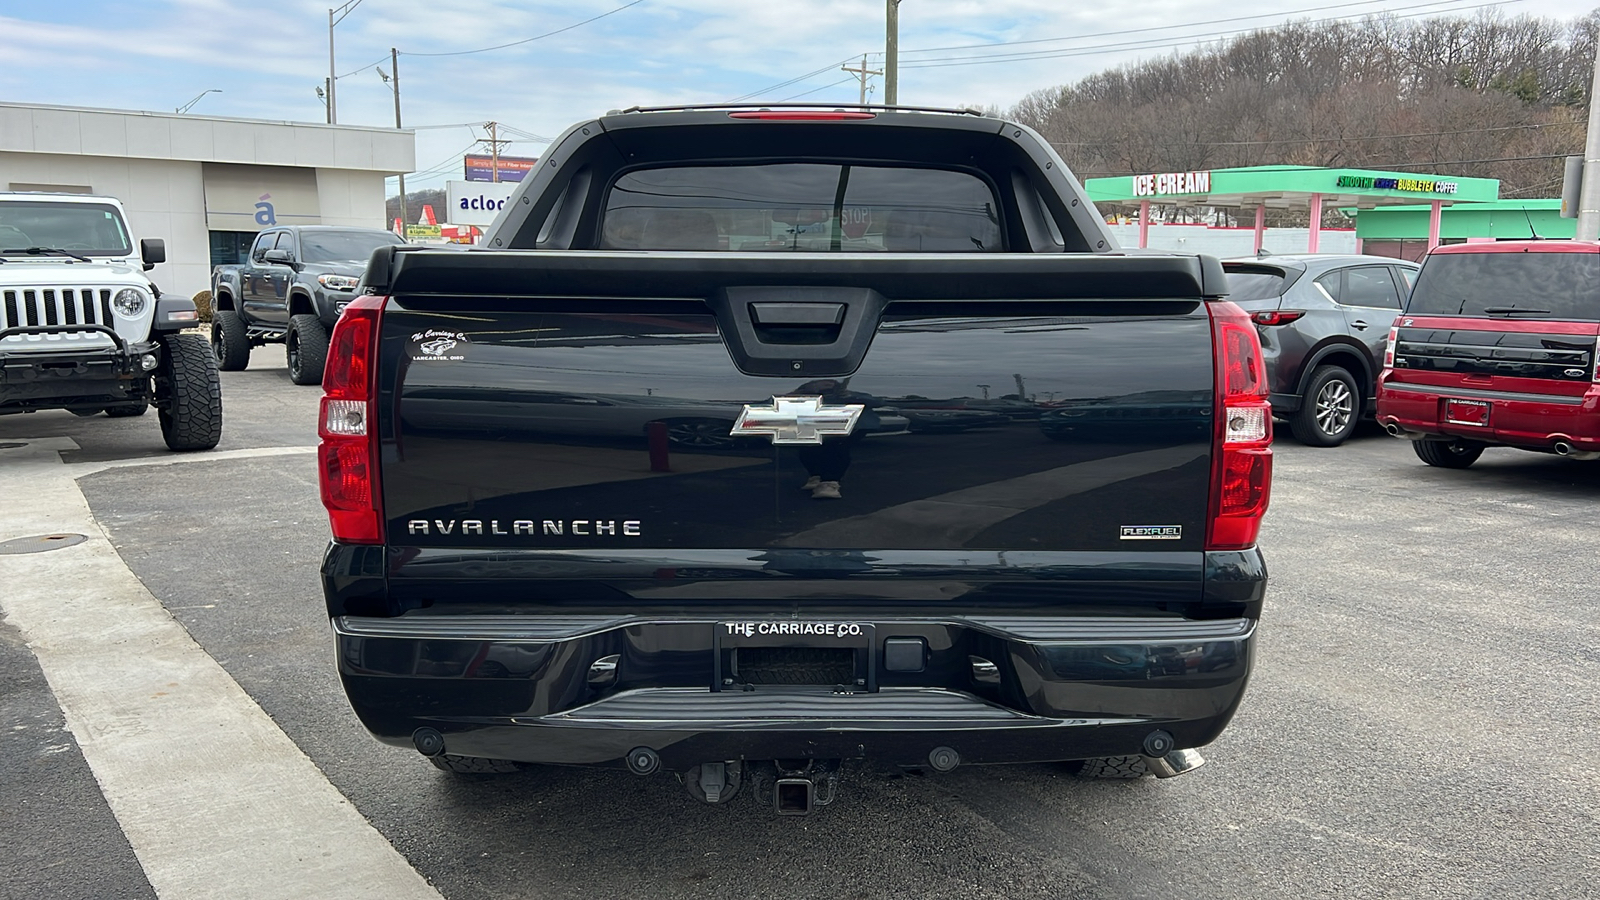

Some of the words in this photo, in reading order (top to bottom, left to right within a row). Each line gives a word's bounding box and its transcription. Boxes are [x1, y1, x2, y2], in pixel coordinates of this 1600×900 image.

[1132, 175, 1156, 196] ICE
[1157, 171, 1210, 194] CREAM
[1398, 179, 1434, 192] BUBBLETEA
[1435, 181, 1458, 193] COFFEE
[460, 194, 510, 211] acloc
[842, 207, 868, 225] STOP
[411, 332, 424, 342] The
[425, 329, 455, 339] Carriage
[408, 519, 641, 535] AVALANCHE
[1123, 527, 1180, 535] FLEXFUEL
[725, 622, 755, 635] THE
[758, 622, 835, 635] CARRIAGE
[838, 622, 863, 636] CO.
